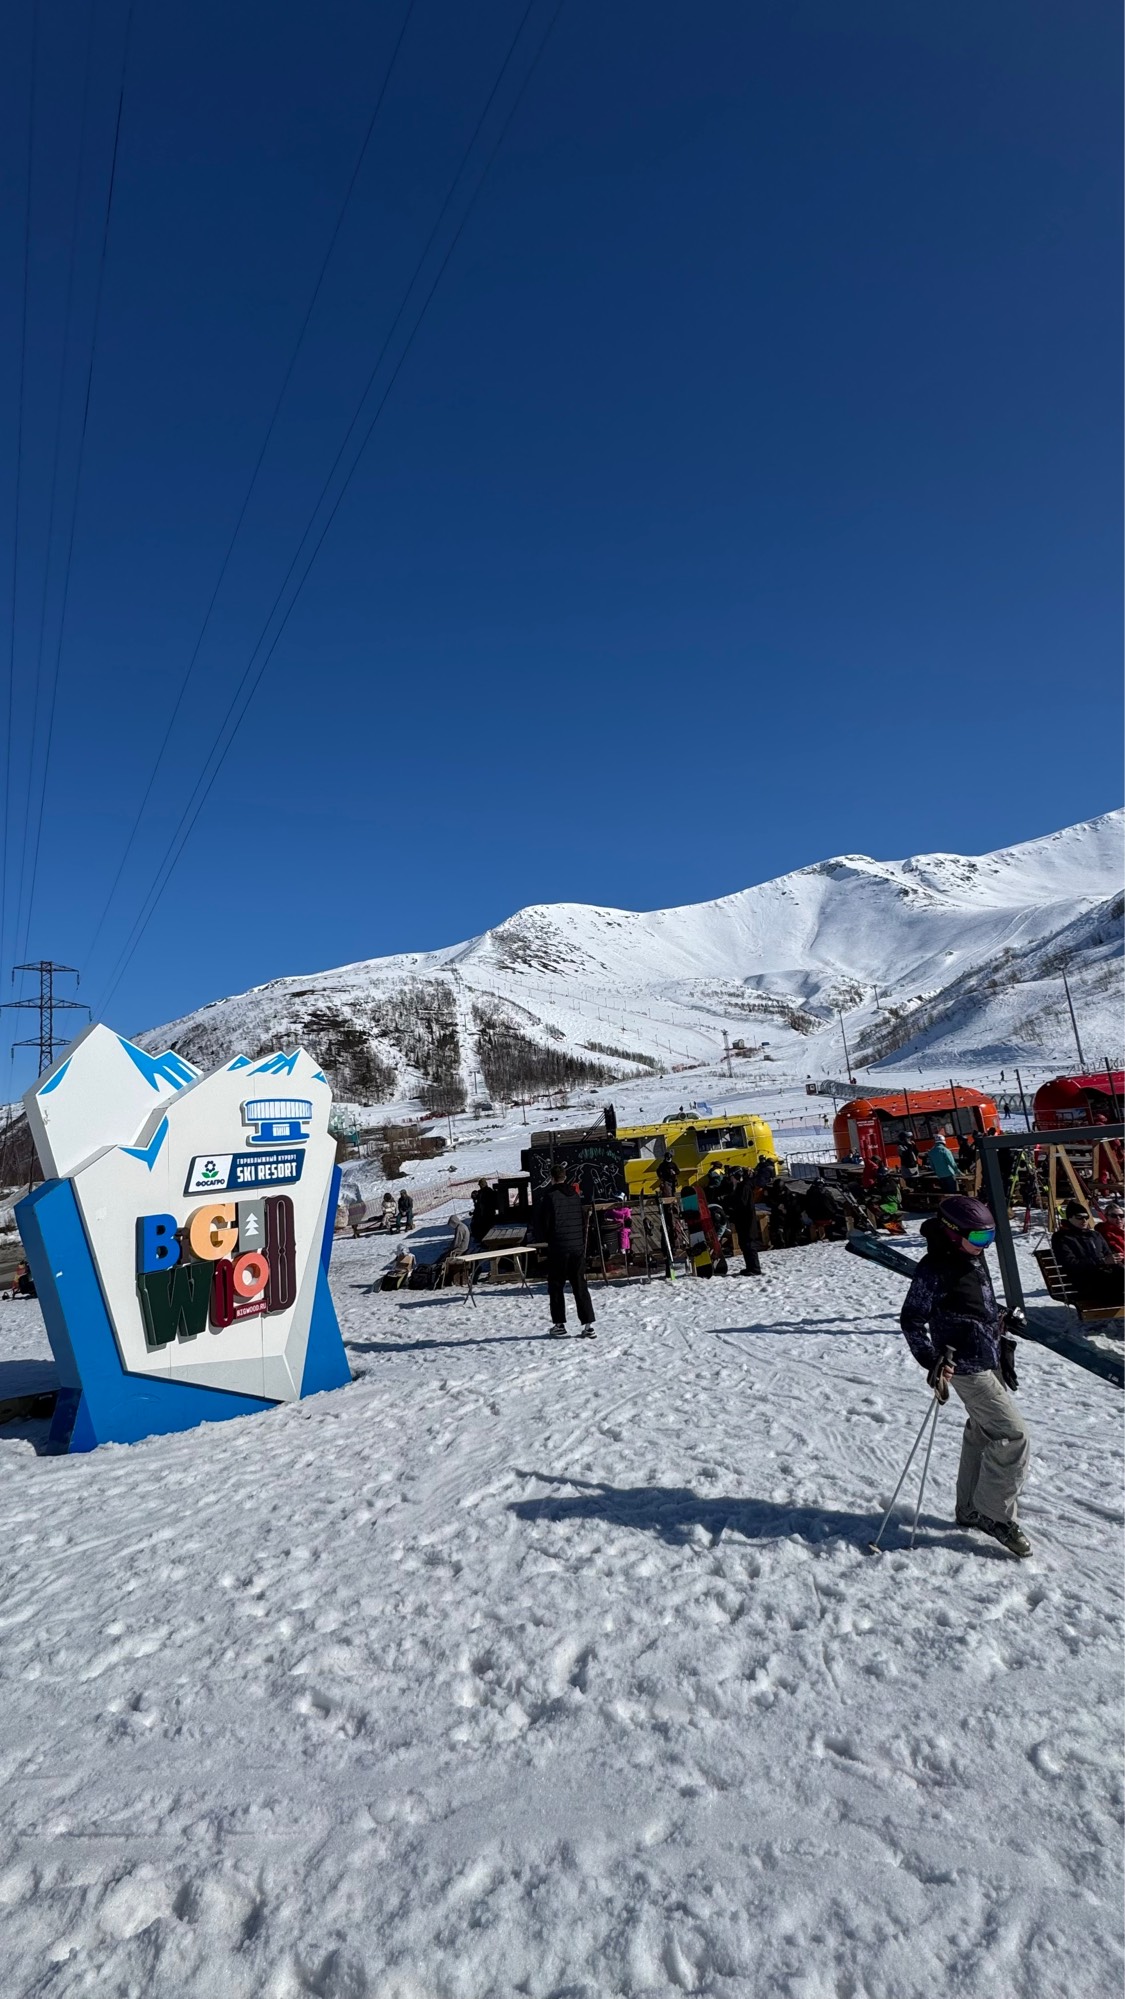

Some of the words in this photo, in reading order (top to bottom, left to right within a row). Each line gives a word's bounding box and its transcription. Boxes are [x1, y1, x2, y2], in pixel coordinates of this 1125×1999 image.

[236, 1165, 255, 1183] SKI
[257, 1162, 297, 1180] RESORT
[195, 1178, 225, 1187] ФОСАГРО
[236, 1302, 267, 1317] BIGWOOD.RU
